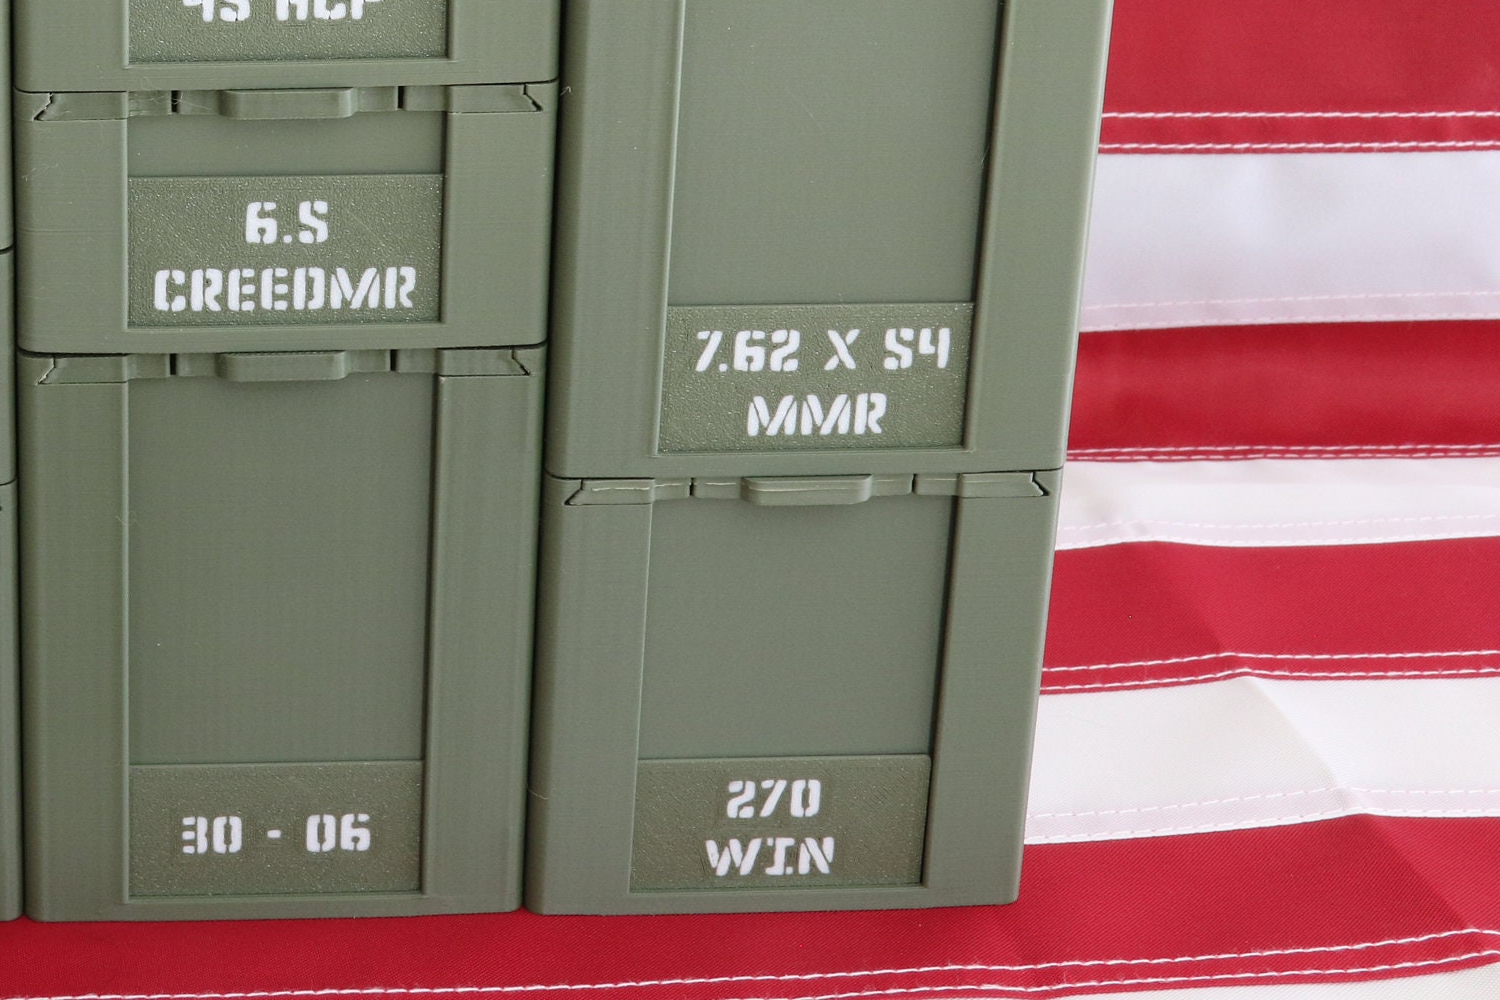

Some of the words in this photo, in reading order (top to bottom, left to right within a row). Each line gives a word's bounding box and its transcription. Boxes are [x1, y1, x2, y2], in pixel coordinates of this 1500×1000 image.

[245, 200, 329, 245] 6.5
[153, 266, 417, 313] CREEDMR
[695, 329, 801, 373] 7.62
[823, 328, 861, 371] X
[883, 327, 951, 371] 54
[747, 392, 887, 437] MMR
[726, 779, 821, 819] 270
[182, 816, 242, 854] 30
[306, 813, 371, 852] 06
[705, 836, 834, 876] WIN
